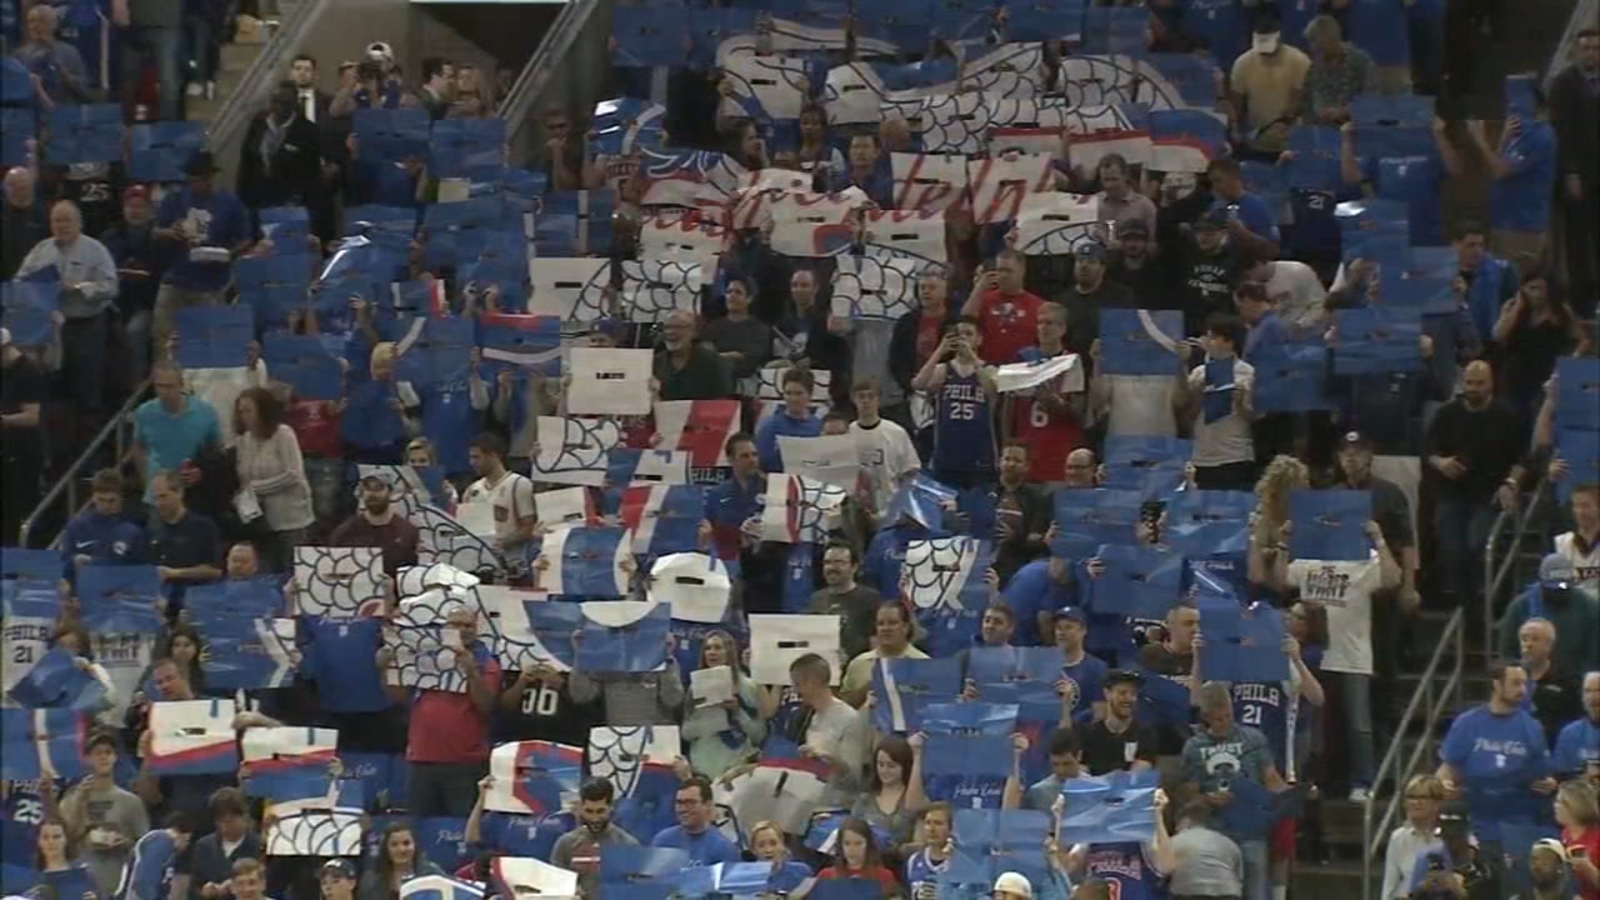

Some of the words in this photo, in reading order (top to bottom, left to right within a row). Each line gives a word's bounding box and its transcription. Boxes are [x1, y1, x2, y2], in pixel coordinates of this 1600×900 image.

[949, 402, 975, 420] 25
[13, 645, 33, 663] 21
[1242, 704, 1262, 725] 21
[13, 799, 42, 825] 25
